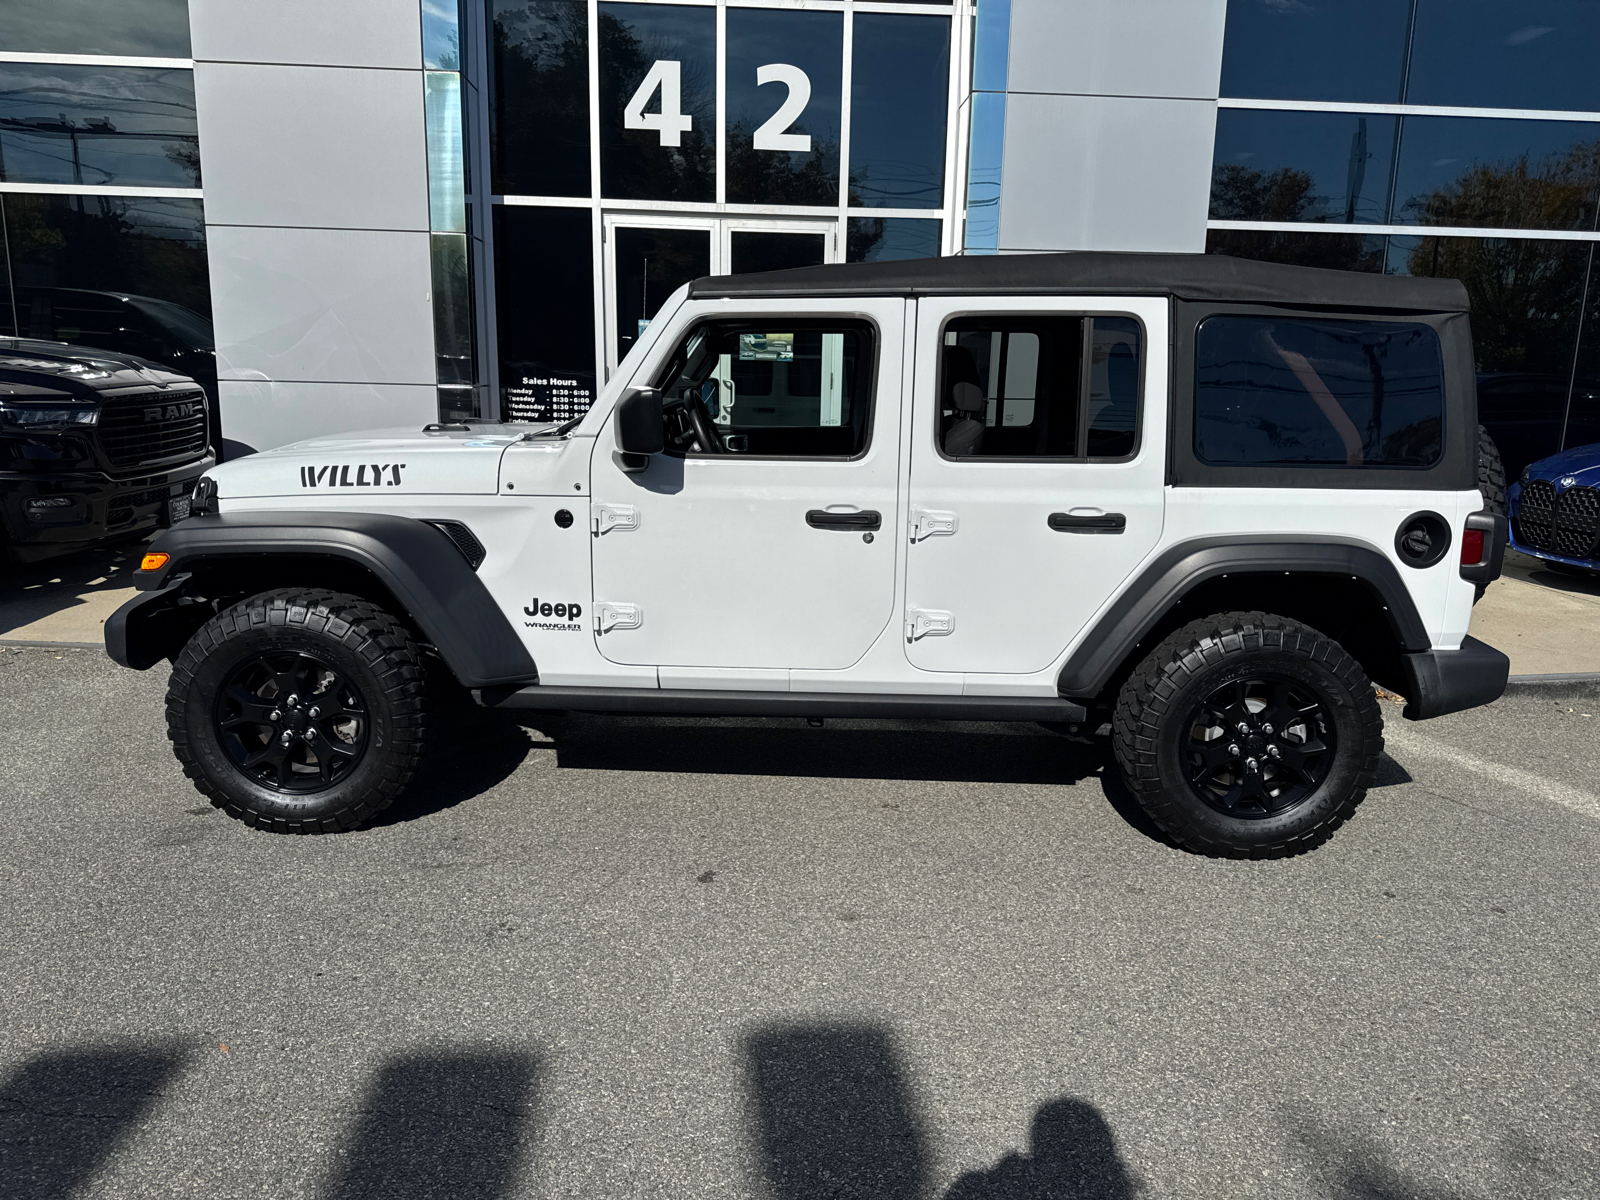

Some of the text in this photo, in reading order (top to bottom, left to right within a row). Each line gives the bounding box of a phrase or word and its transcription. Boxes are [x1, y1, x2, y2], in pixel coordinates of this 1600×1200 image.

[522, 377, 578, 386] Sales Hours
[508, 395, 536, 403] Tuesday
[508, 403, 545, 411] Wednesday
[143, 403, 194, 422] RAM
[300, 463, 406, 488] WILLYS
[523, 597, 582, 622] Jeep
[523, 621, 582, 629] WRANGLER
